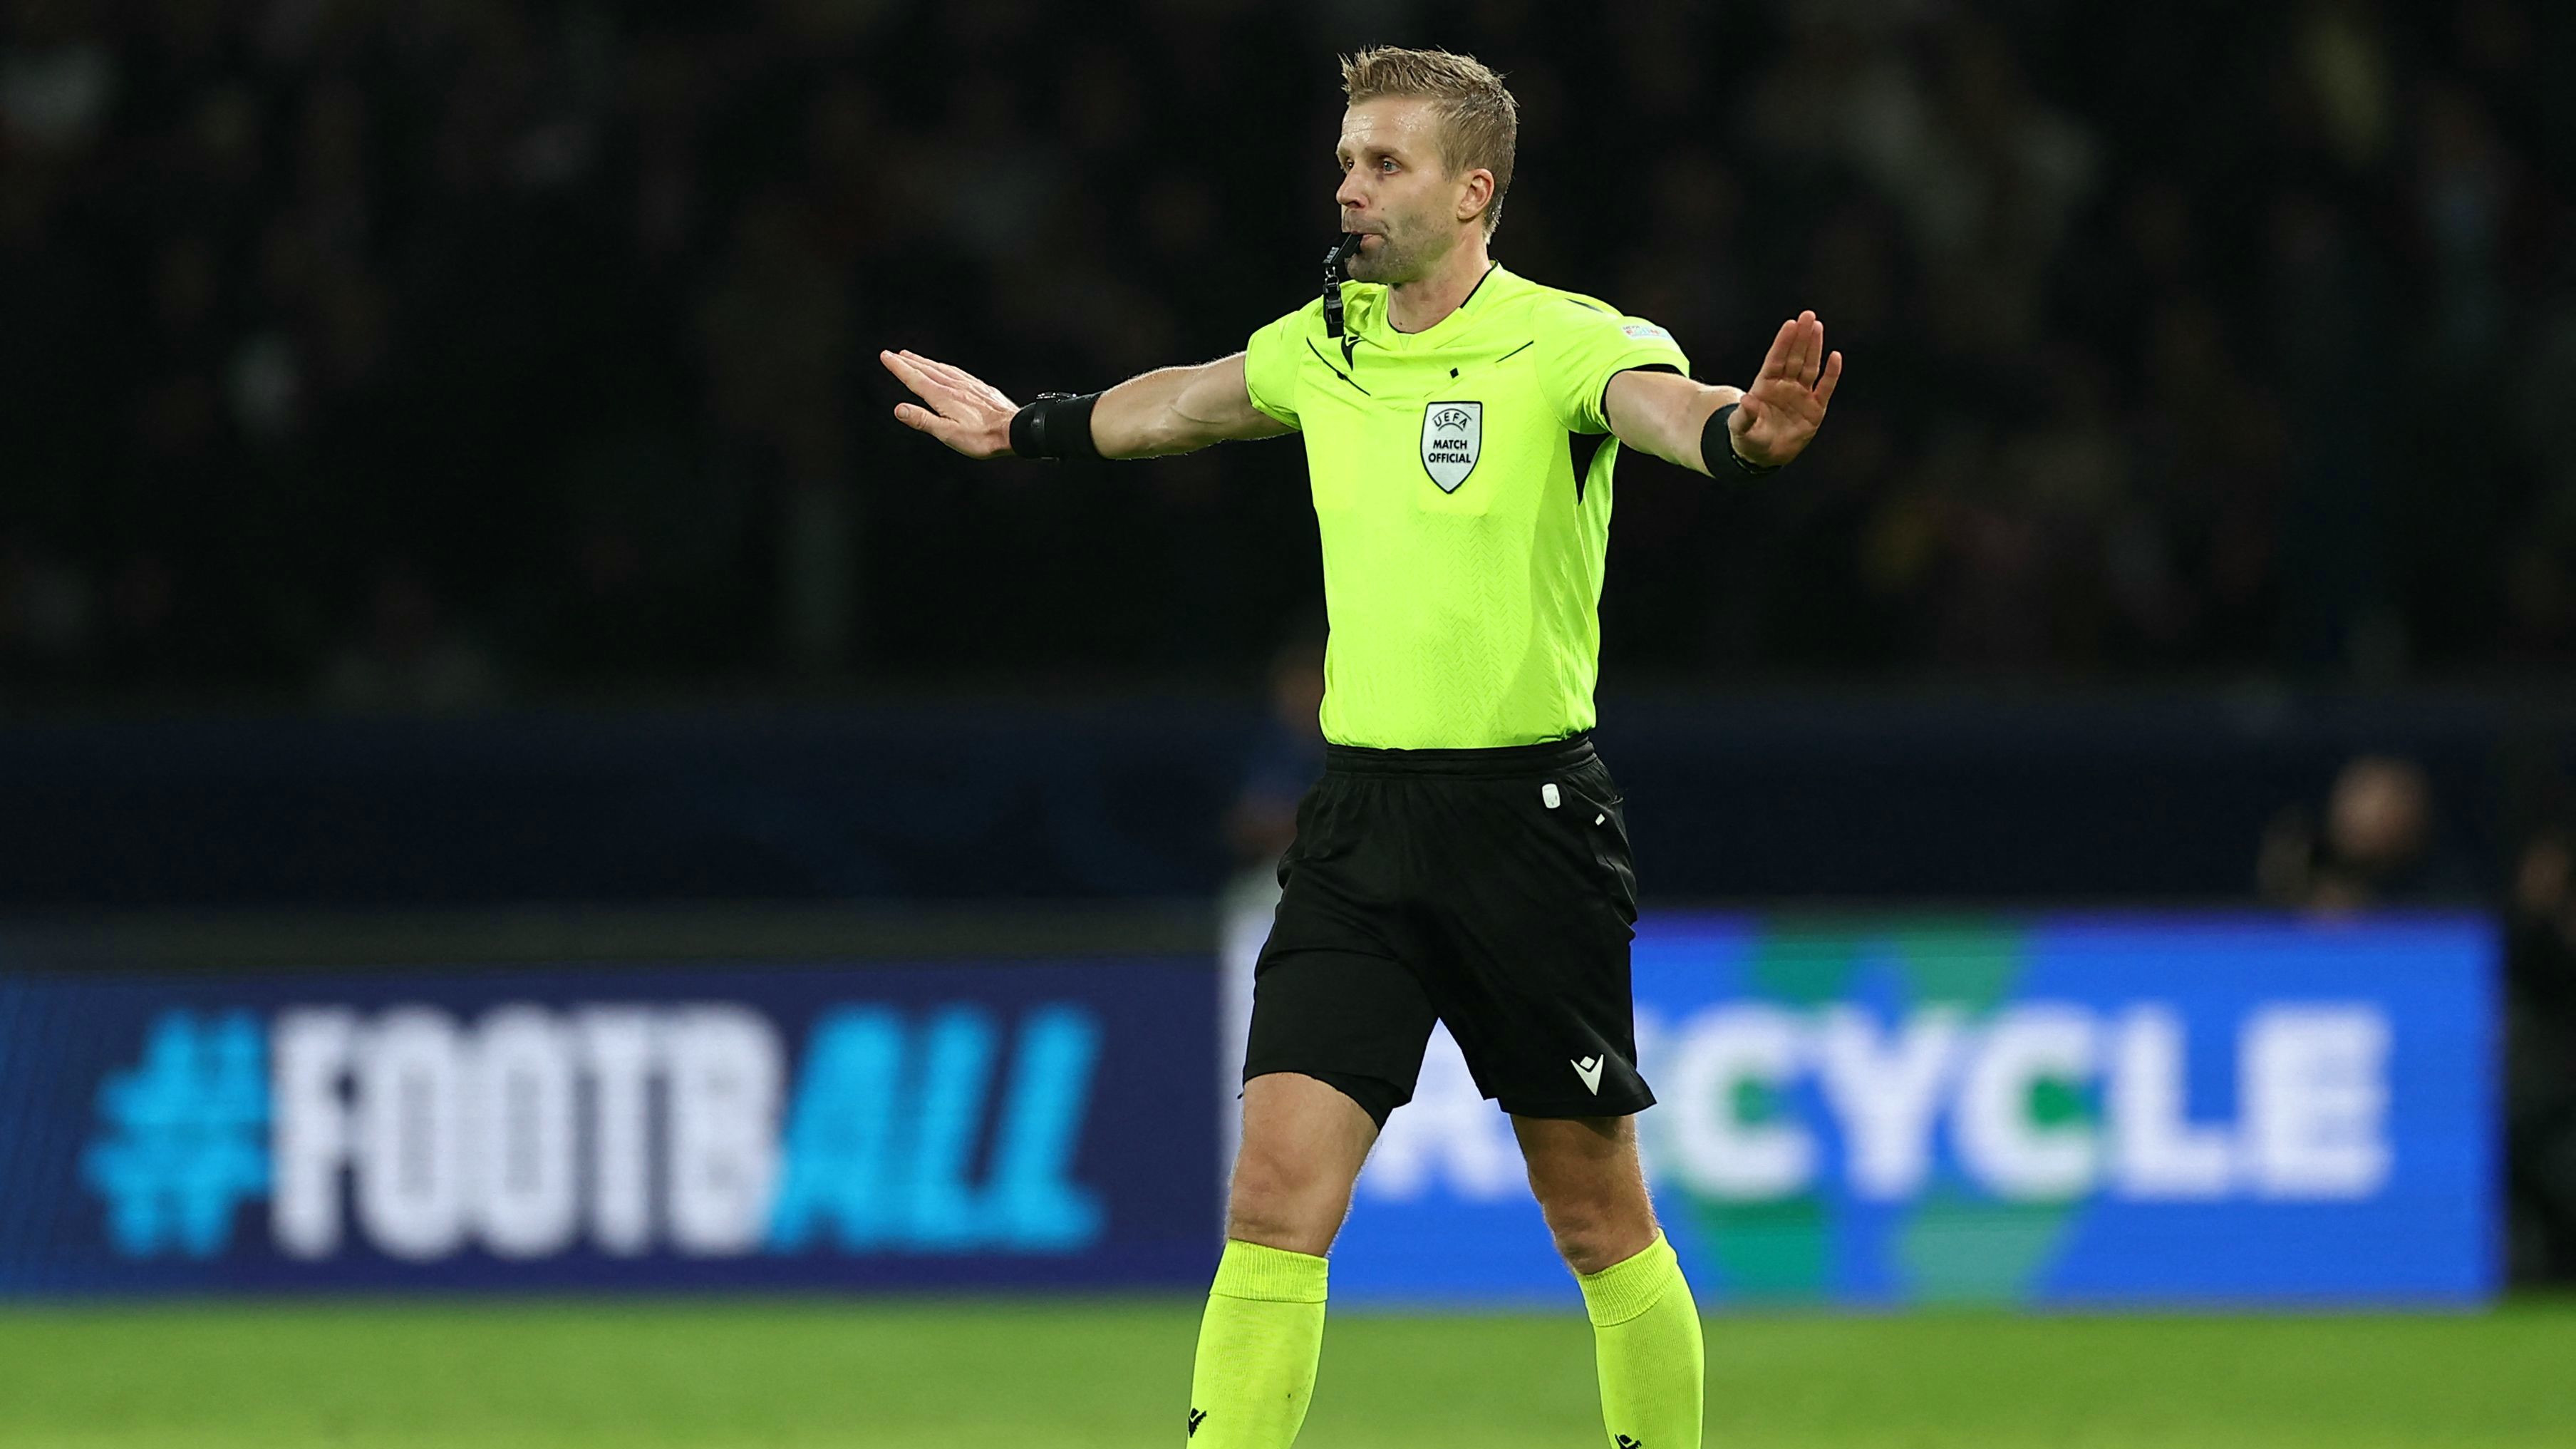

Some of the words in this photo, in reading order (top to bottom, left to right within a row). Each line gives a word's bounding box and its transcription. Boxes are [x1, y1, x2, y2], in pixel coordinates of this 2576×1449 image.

[1434, 411, 1467, 428] UEFA
[1433, 440, 1467, 449] MATCH
[1428, 453, 1471, 463] OFFICIAL
[1354, 1004, 2391, 1201] RCYCLE
[84, 1004, 1105, 1258] #FOOTBALL
